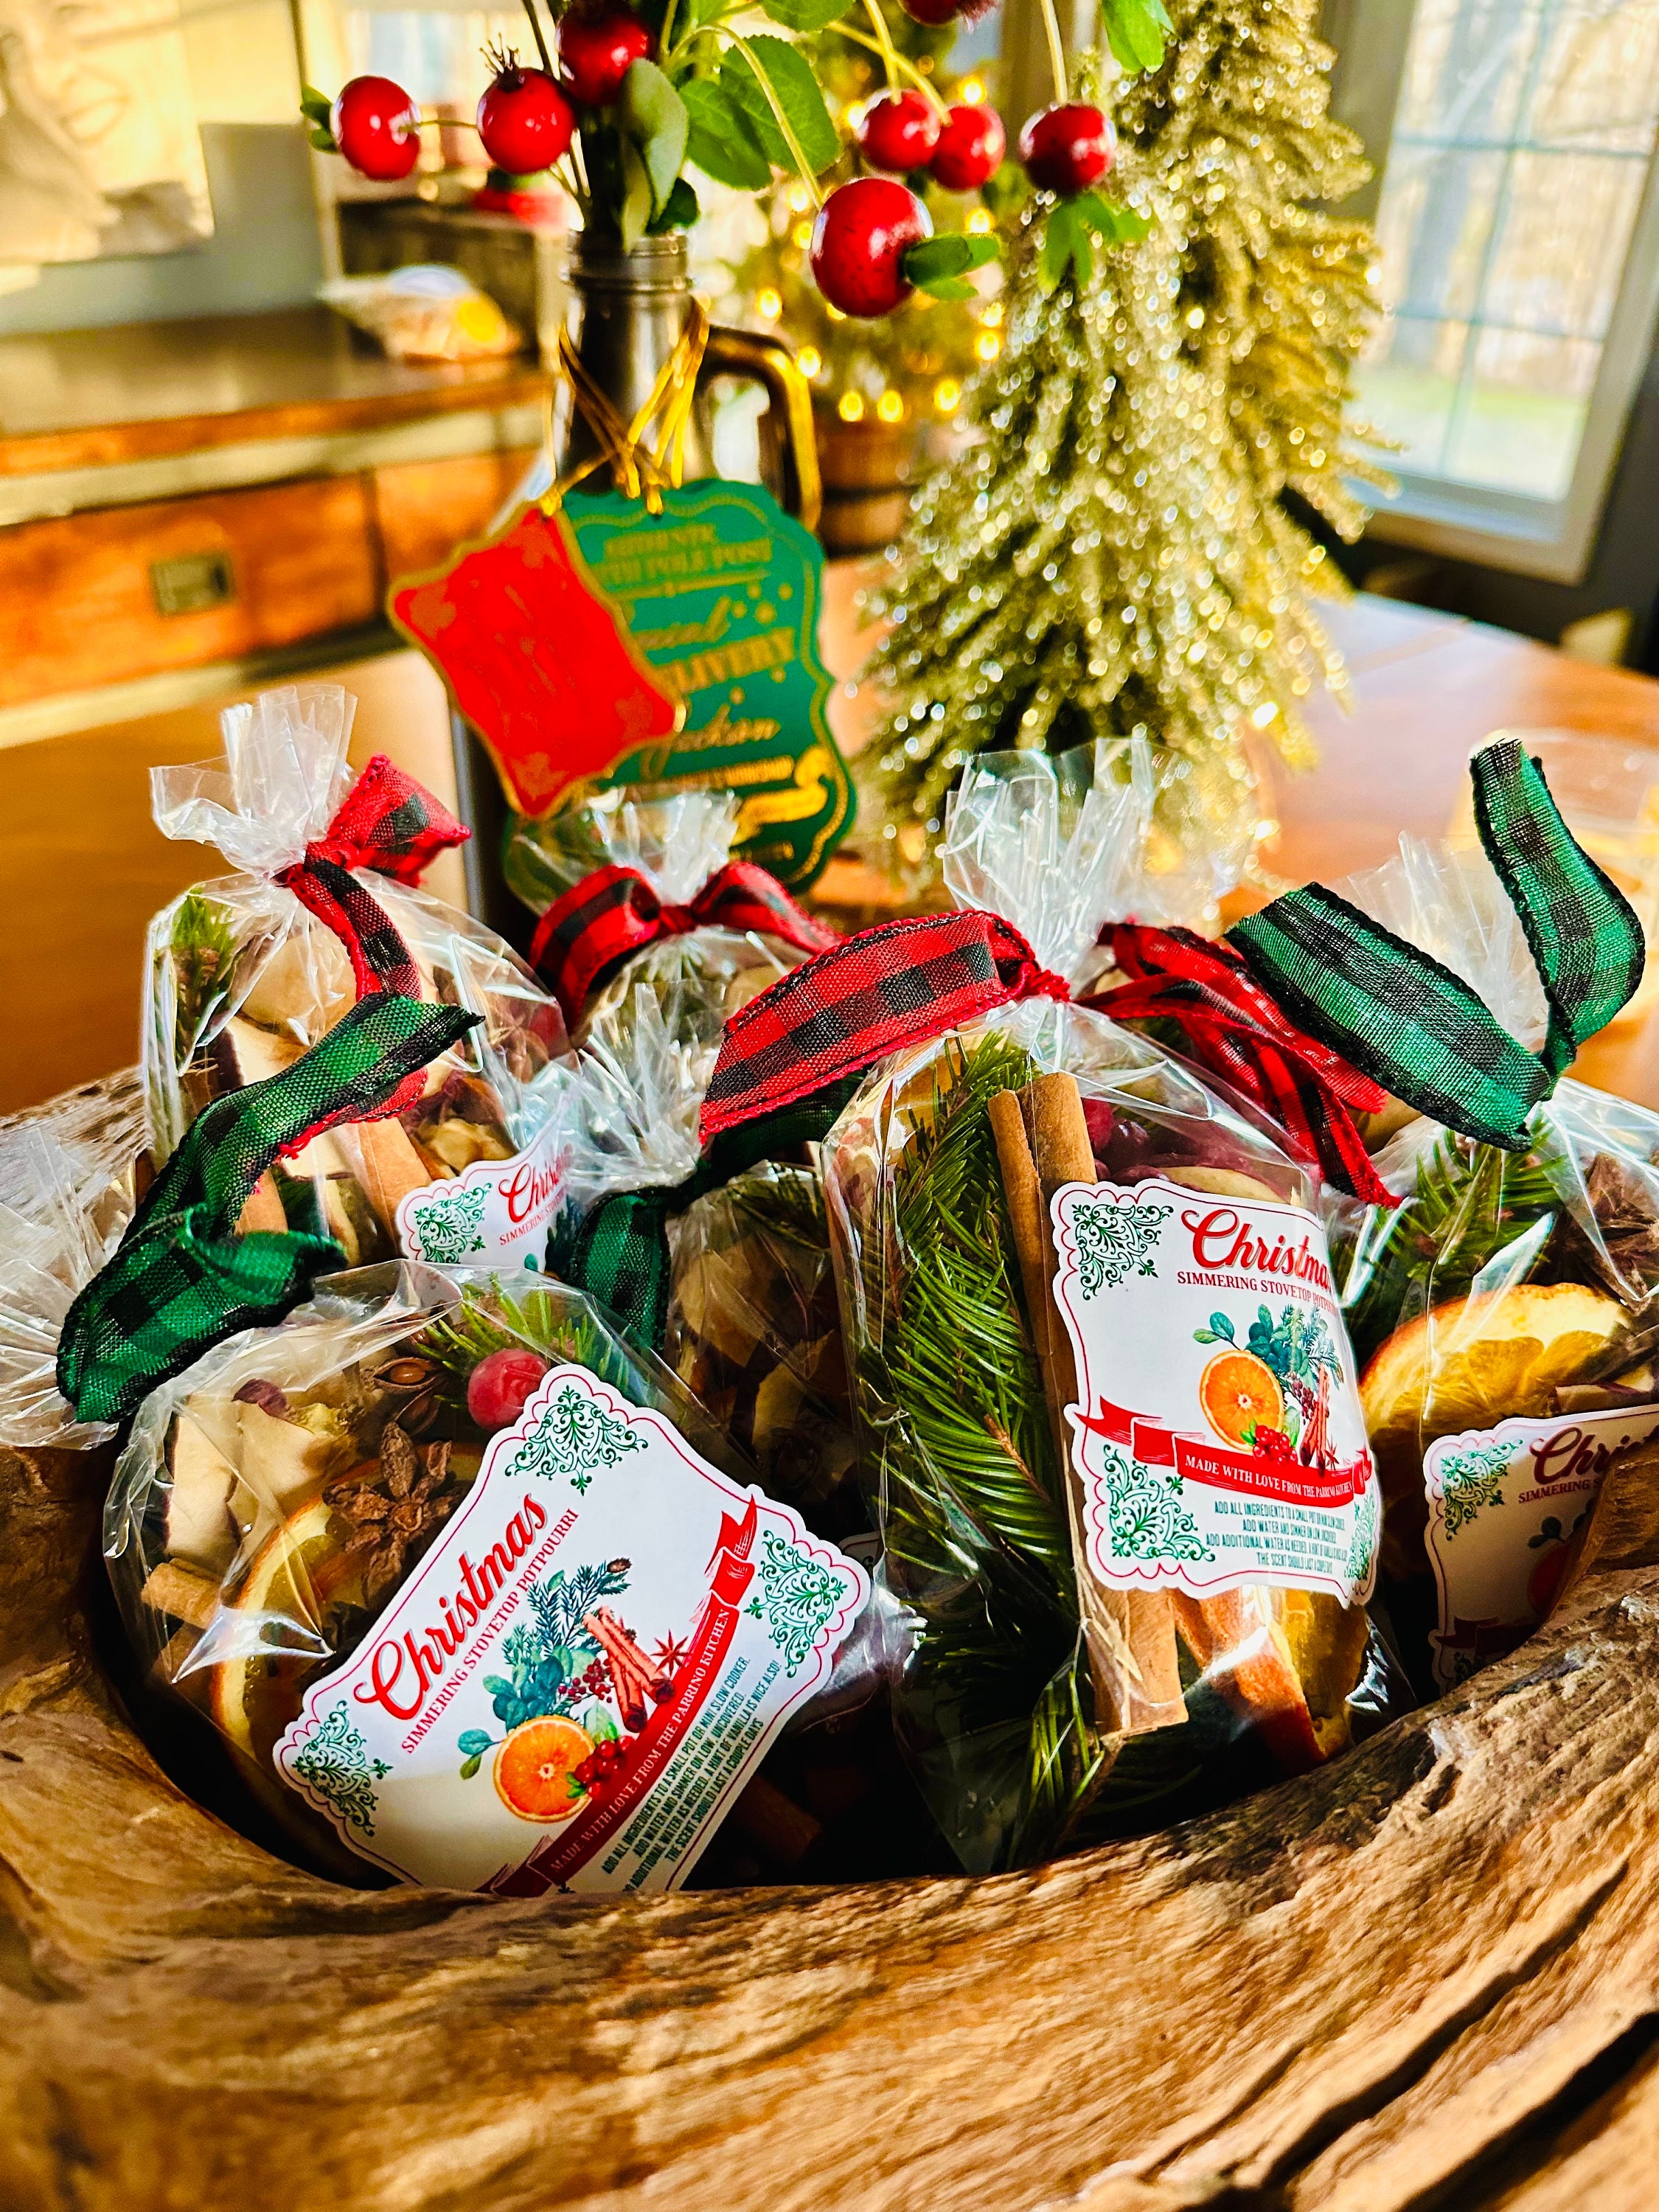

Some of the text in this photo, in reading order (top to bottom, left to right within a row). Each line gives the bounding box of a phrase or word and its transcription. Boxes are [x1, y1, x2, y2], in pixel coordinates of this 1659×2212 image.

[1178, 1272, 1257, 1290] SIMMERING
[1261, 1279, 1312, 1302] STOVETOP
[1186, 1455, 1219, 1475] MADE
[1222, 1463, 1253, 1484] WITH
[1255, 1473, 1280, 1490] LOVE
[1281, 1480, 1301, 1495] FROM
[1302, 1485, 1315, 1497] THE
[1518, 1481, 1590, 1503] SIMMERING
[1214, 1501, 1228, 1514] ADD
[1231, 1502, 1242, 1514] ALL
[1244, 1503, 1284, 1518] INGREDIENTS
[1243, 1519, 1256, 1531] ADD
[1258, 1520, 1279, 1534] WATER
[1206, 1533, 1220, 1546] ADD
[1222, 1534, 1262, 1548] ADDITIONAL
[1265, 1537, 1283, 1549] WATER
[1256, 1552, 1269, 1565] THE
[353, 1495, 545, 1720] Christmas
[400, 1508, 579, 1755] SIMMERING STOVETOP POTPOURRI
[761, 1659, 782, 1685] ALSO!
[745, 1699, 758, 1711] IS
[751, 1681, 769, 1703] NICE
[726, 1708, 753, 1742] VANILLA
[549, 1608, 730, 1873] MADE WITH LOVE FROM THE PARRINO KITCHEN
[719, 1738, 734, 1753] OF
[601, 1654, 751, 1875] ADD ALL INGREDIENTS TO A SMALL POT OR MINI SLOW COOKER.
[703, 1767, 714, 1777] A
[707, 1748, 726, 1770] HINT
[664, 1717, 764, 1863] THE SCENT SHOULD LAST A COUPLE DAYS
[632, 1837, 650, 1857] ADD
[642, 1812, 668, 1842] WATER
[660, 1795, 678, 1816] AND
[671, 1767, 697, 1800] SIMMER
[689, 1755, 705, 1770] ON
[676, 1805, 690, 1819] AS
[658, 1815, 684, 1846] WATER
[629, 1841, 666, 1888] ADDITIONAL
